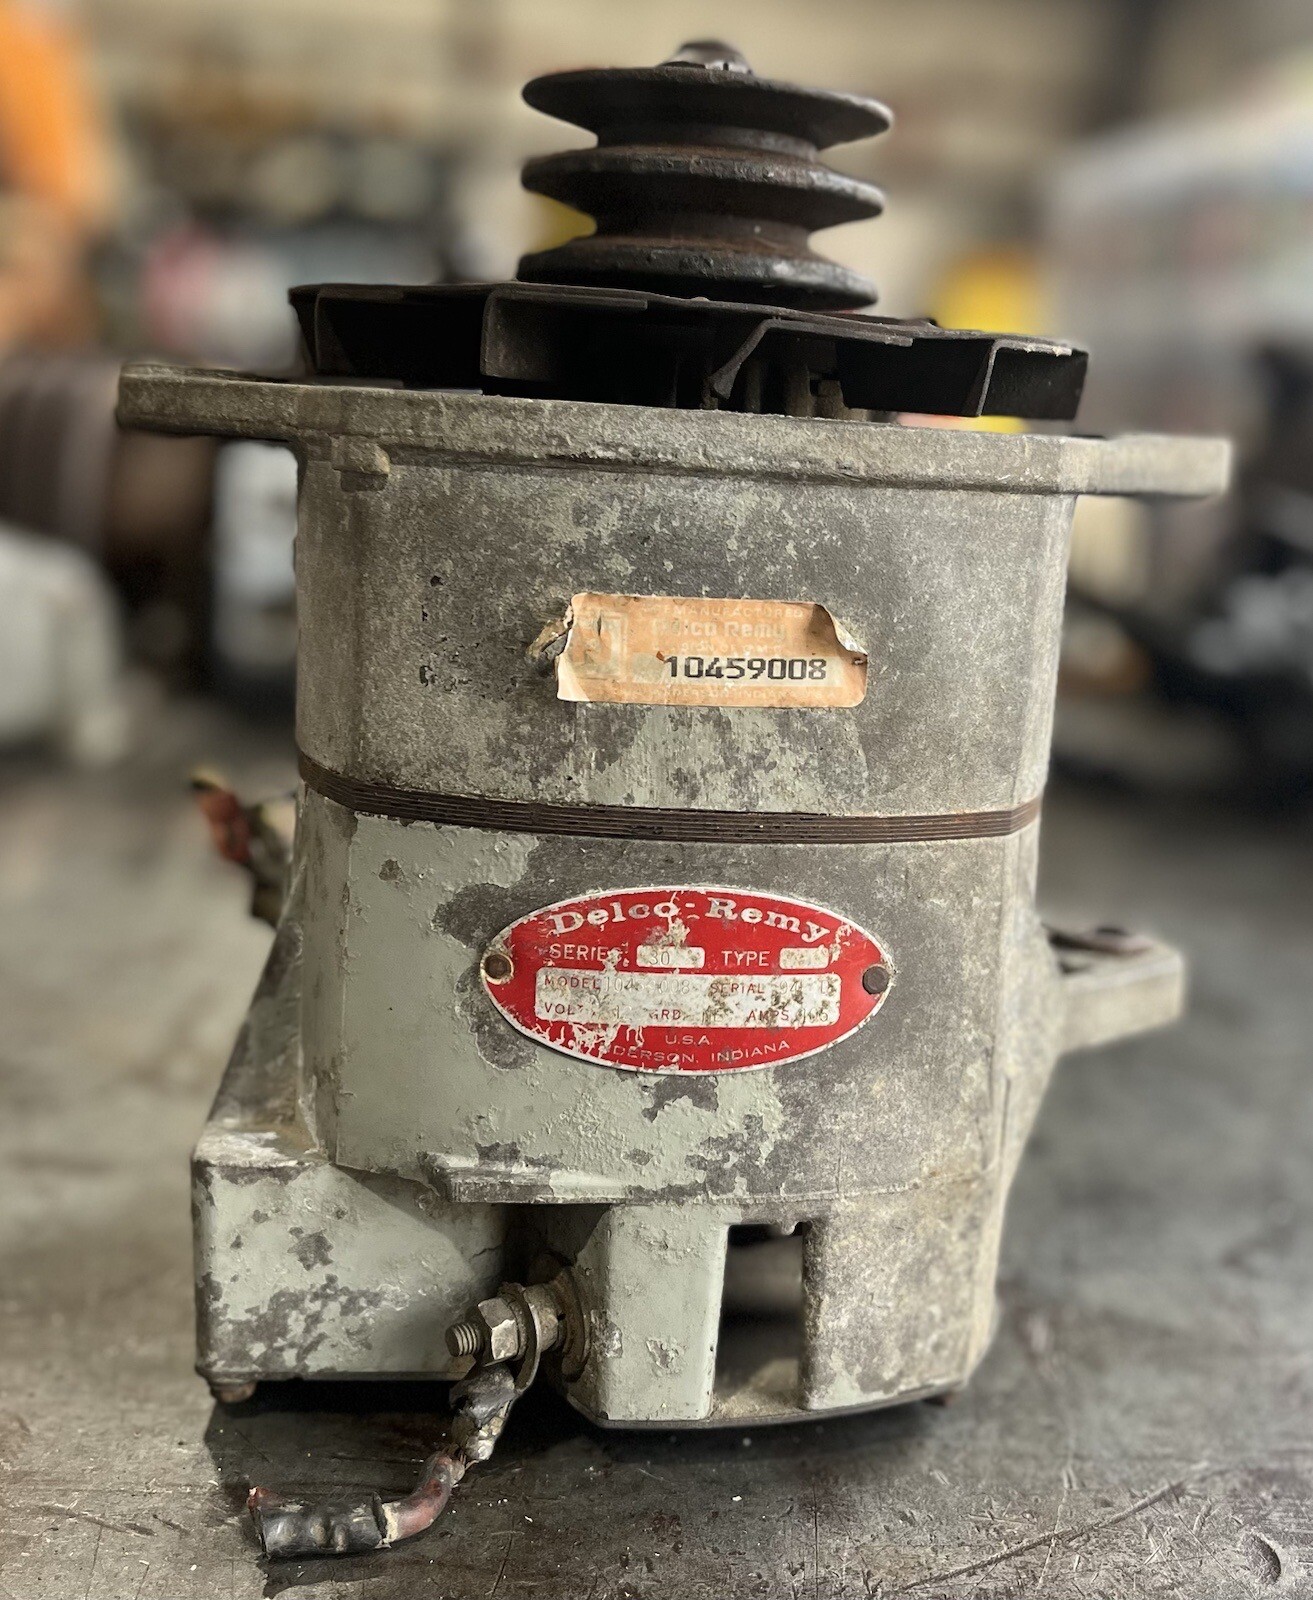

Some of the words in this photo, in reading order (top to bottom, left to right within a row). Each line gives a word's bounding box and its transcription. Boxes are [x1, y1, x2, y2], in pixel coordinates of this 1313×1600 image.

[666, 656, 827, 680] 10459008
[549, 897, 830, 943] Delco-Remy
[721, 950, 771, 967] TYPE
[544, 974, 600, 990] MODEL
[711, 1039, 791, 1063] INDIANA
